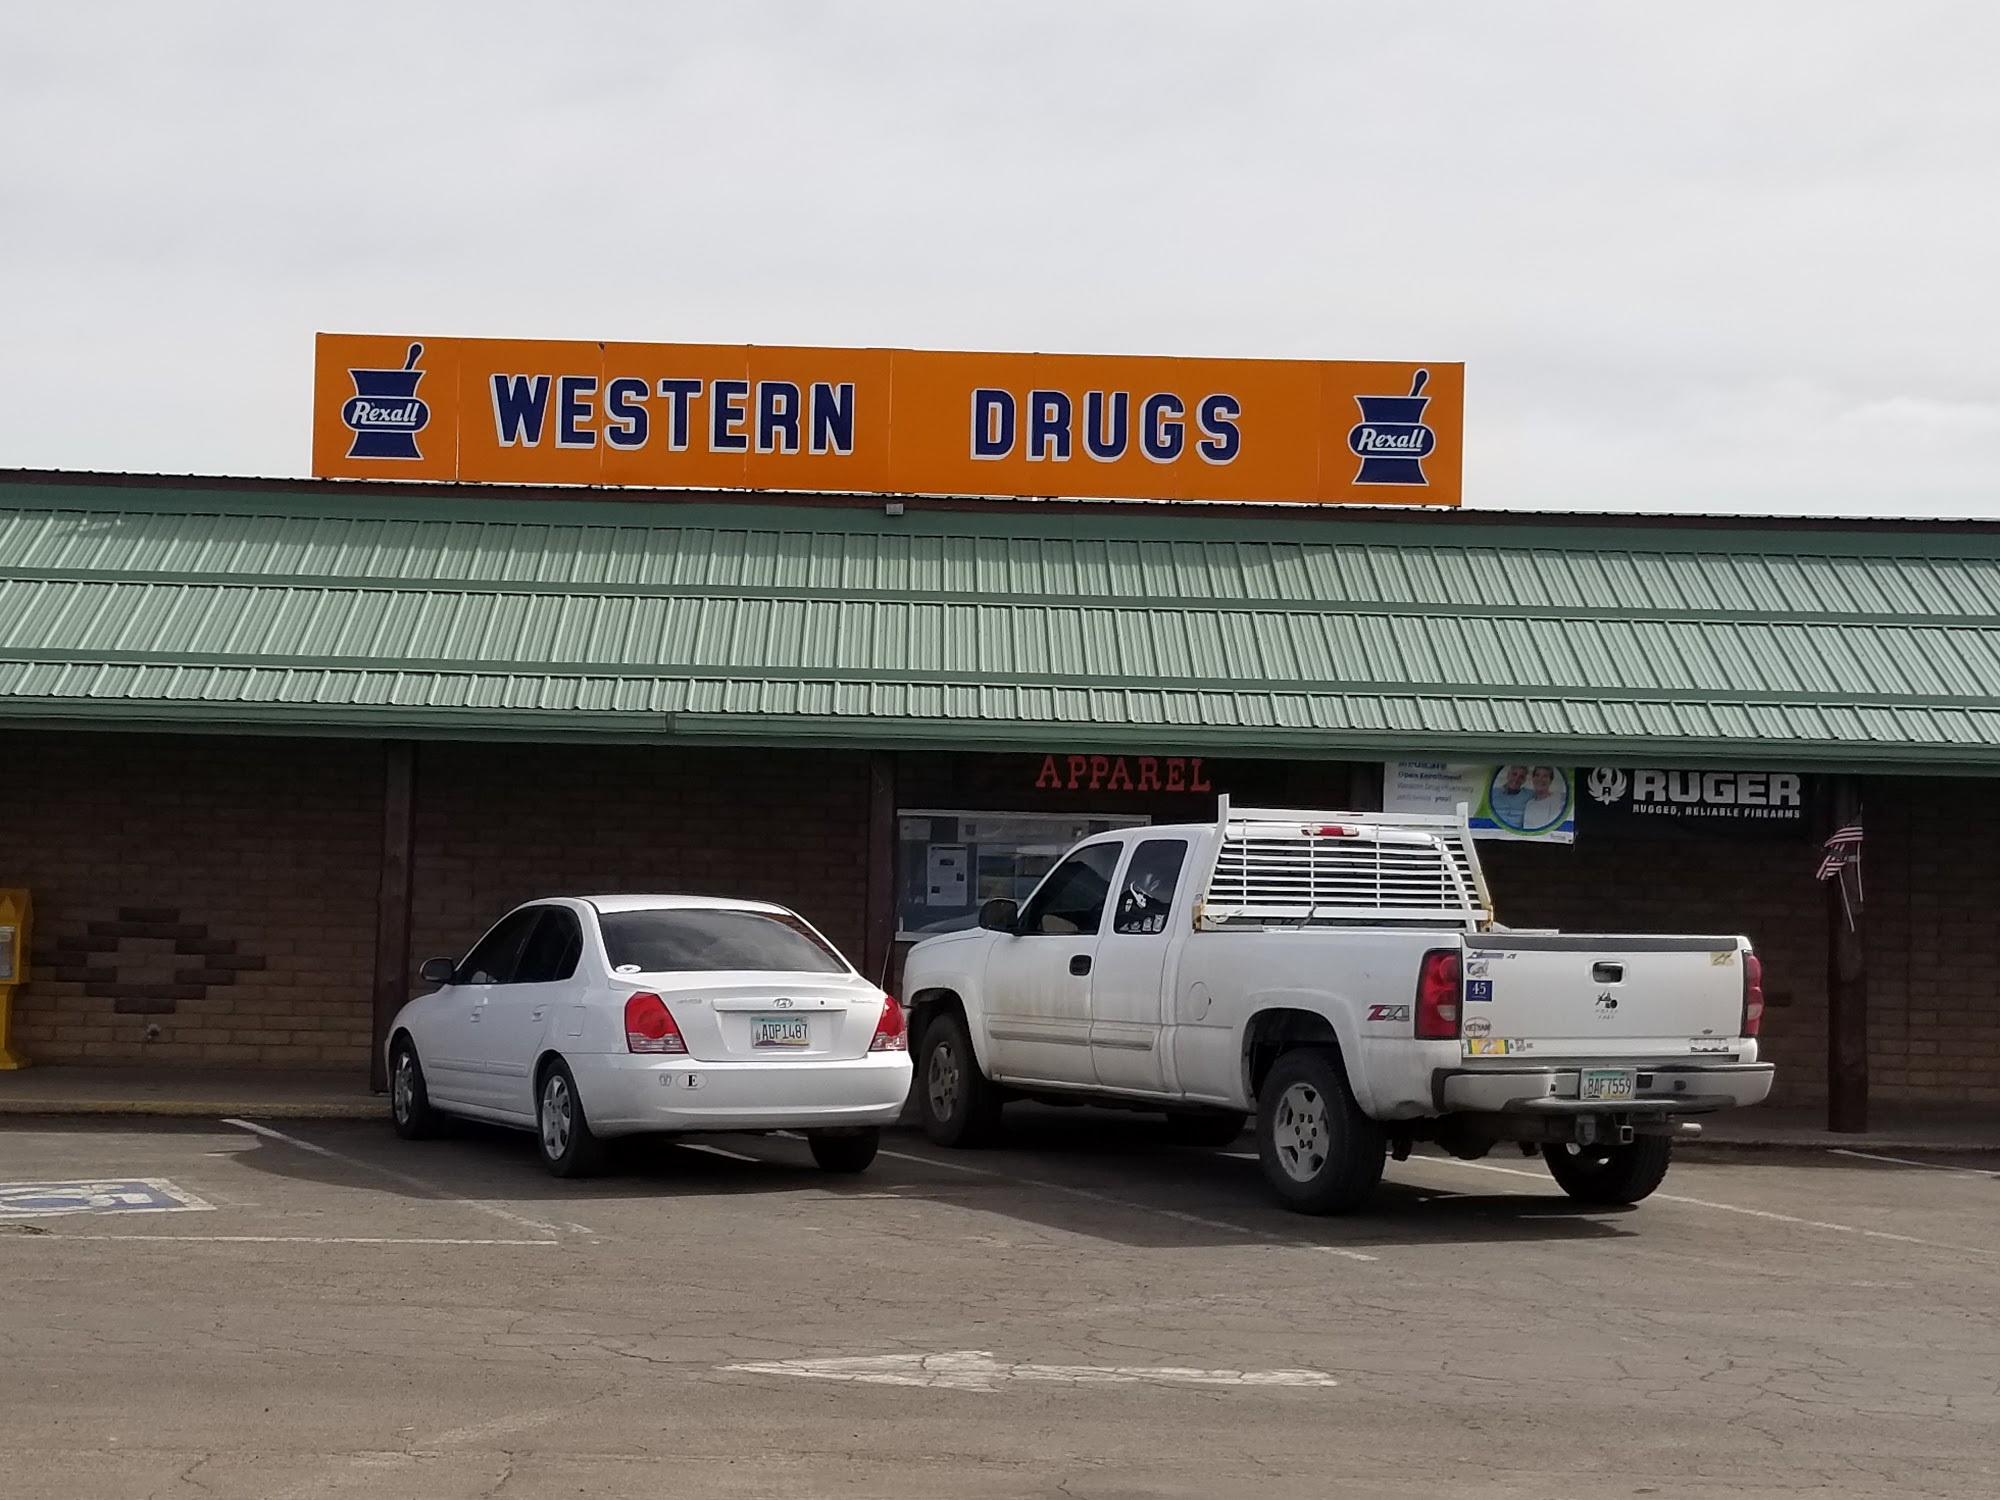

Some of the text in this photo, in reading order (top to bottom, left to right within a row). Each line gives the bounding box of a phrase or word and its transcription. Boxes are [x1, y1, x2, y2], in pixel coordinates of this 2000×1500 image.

[351, 401, 420, 426] Rexall
[489, 373, 1242, 465] WESTERN DRUGS
[1357, 428, 1426, 452] Rexall
[1035, 755, 1211, 791] APPAREL
[1633, 769, 1801, 806] RUGER
[1633, 804, 1800, 819] RUGGED, RELIABLE FIREARMS
[1472, 982, 1486, 995] 45
[762, 1023, 808, 1041] ADP1487
[688, 1075, 698, 1087] E
[1587, 1078, 1632, 1095] BAF7559
